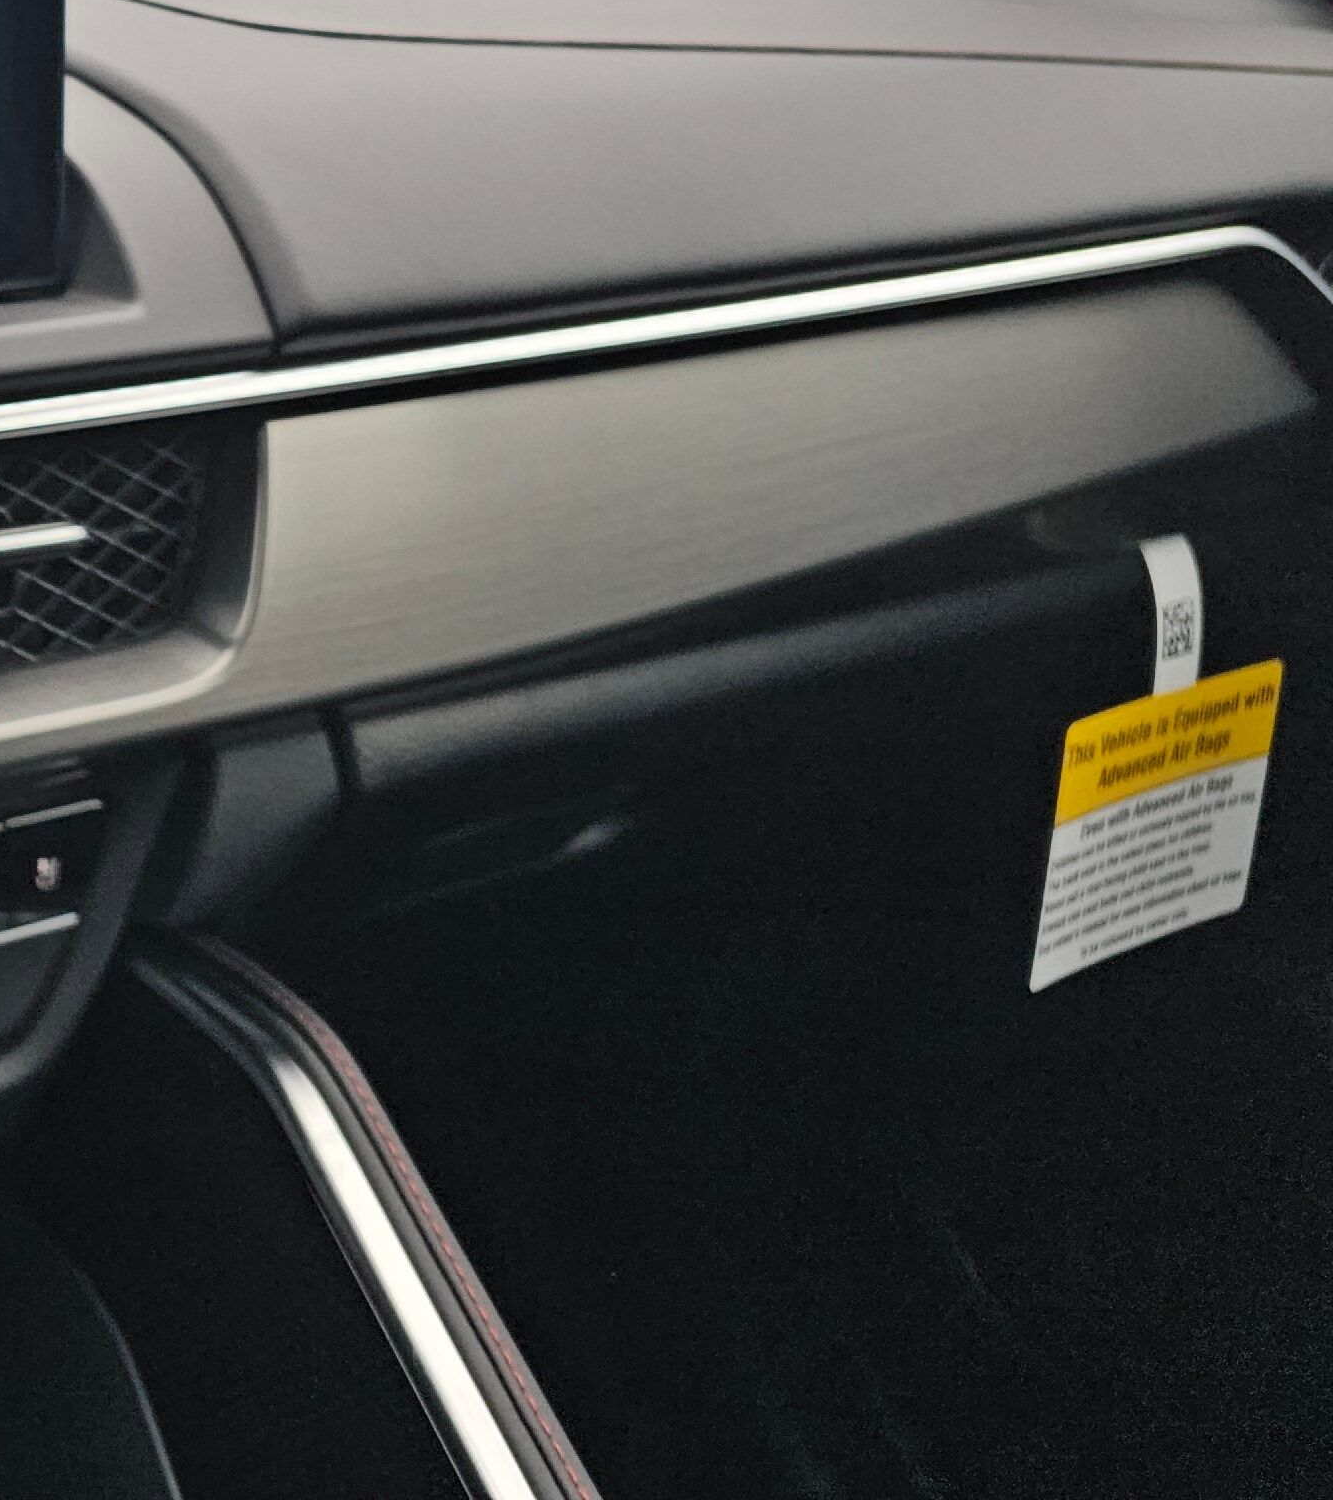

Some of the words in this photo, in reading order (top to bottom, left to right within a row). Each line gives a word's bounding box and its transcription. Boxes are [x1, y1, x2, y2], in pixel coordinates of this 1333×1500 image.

[1067, 743, 1098, 768] This
[1100, 722, 1152, 757] Vehicle
[1156, 713, 1170, 737] is
[1173, 692, 1240, 733] Equipped
[1243, 683, 1277, 711] with
[1098, 748, 1167, 790] Advanced
[1170, 739, 1192, 765] Air
[1195, 729, 1232, 756] Bags
[1133, 786, 1185, 818] Advanced
